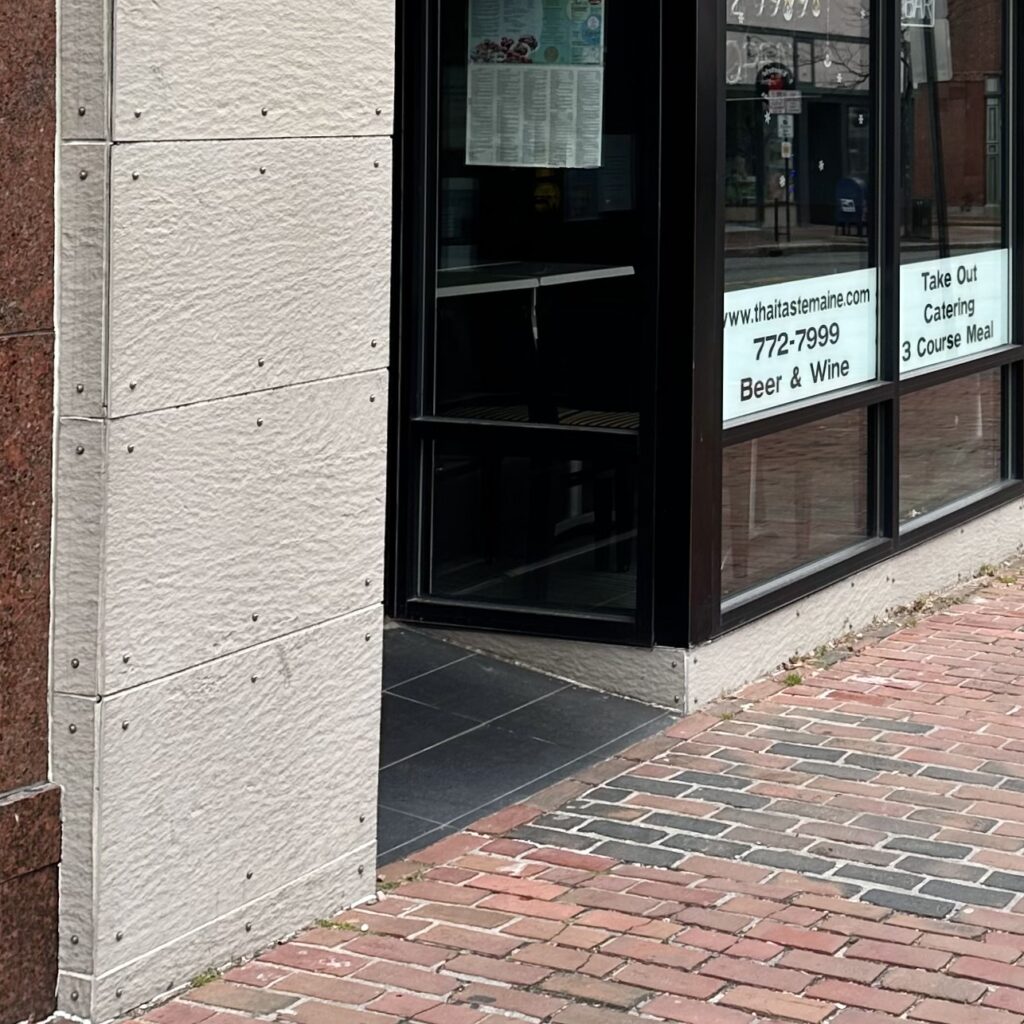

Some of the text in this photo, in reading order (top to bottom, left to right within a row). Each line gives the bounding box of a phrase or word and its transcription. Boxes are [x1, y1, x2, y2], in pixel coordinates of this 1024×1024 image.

[921, 264, 978, 292] Take Out
[924, 296, 975, 324] Catering
[753, 322, 840, 361] 772-7999
[902, 320, 994, 362] 3 Course Meal
[740, 358, 850, 402] Beer & Wine
